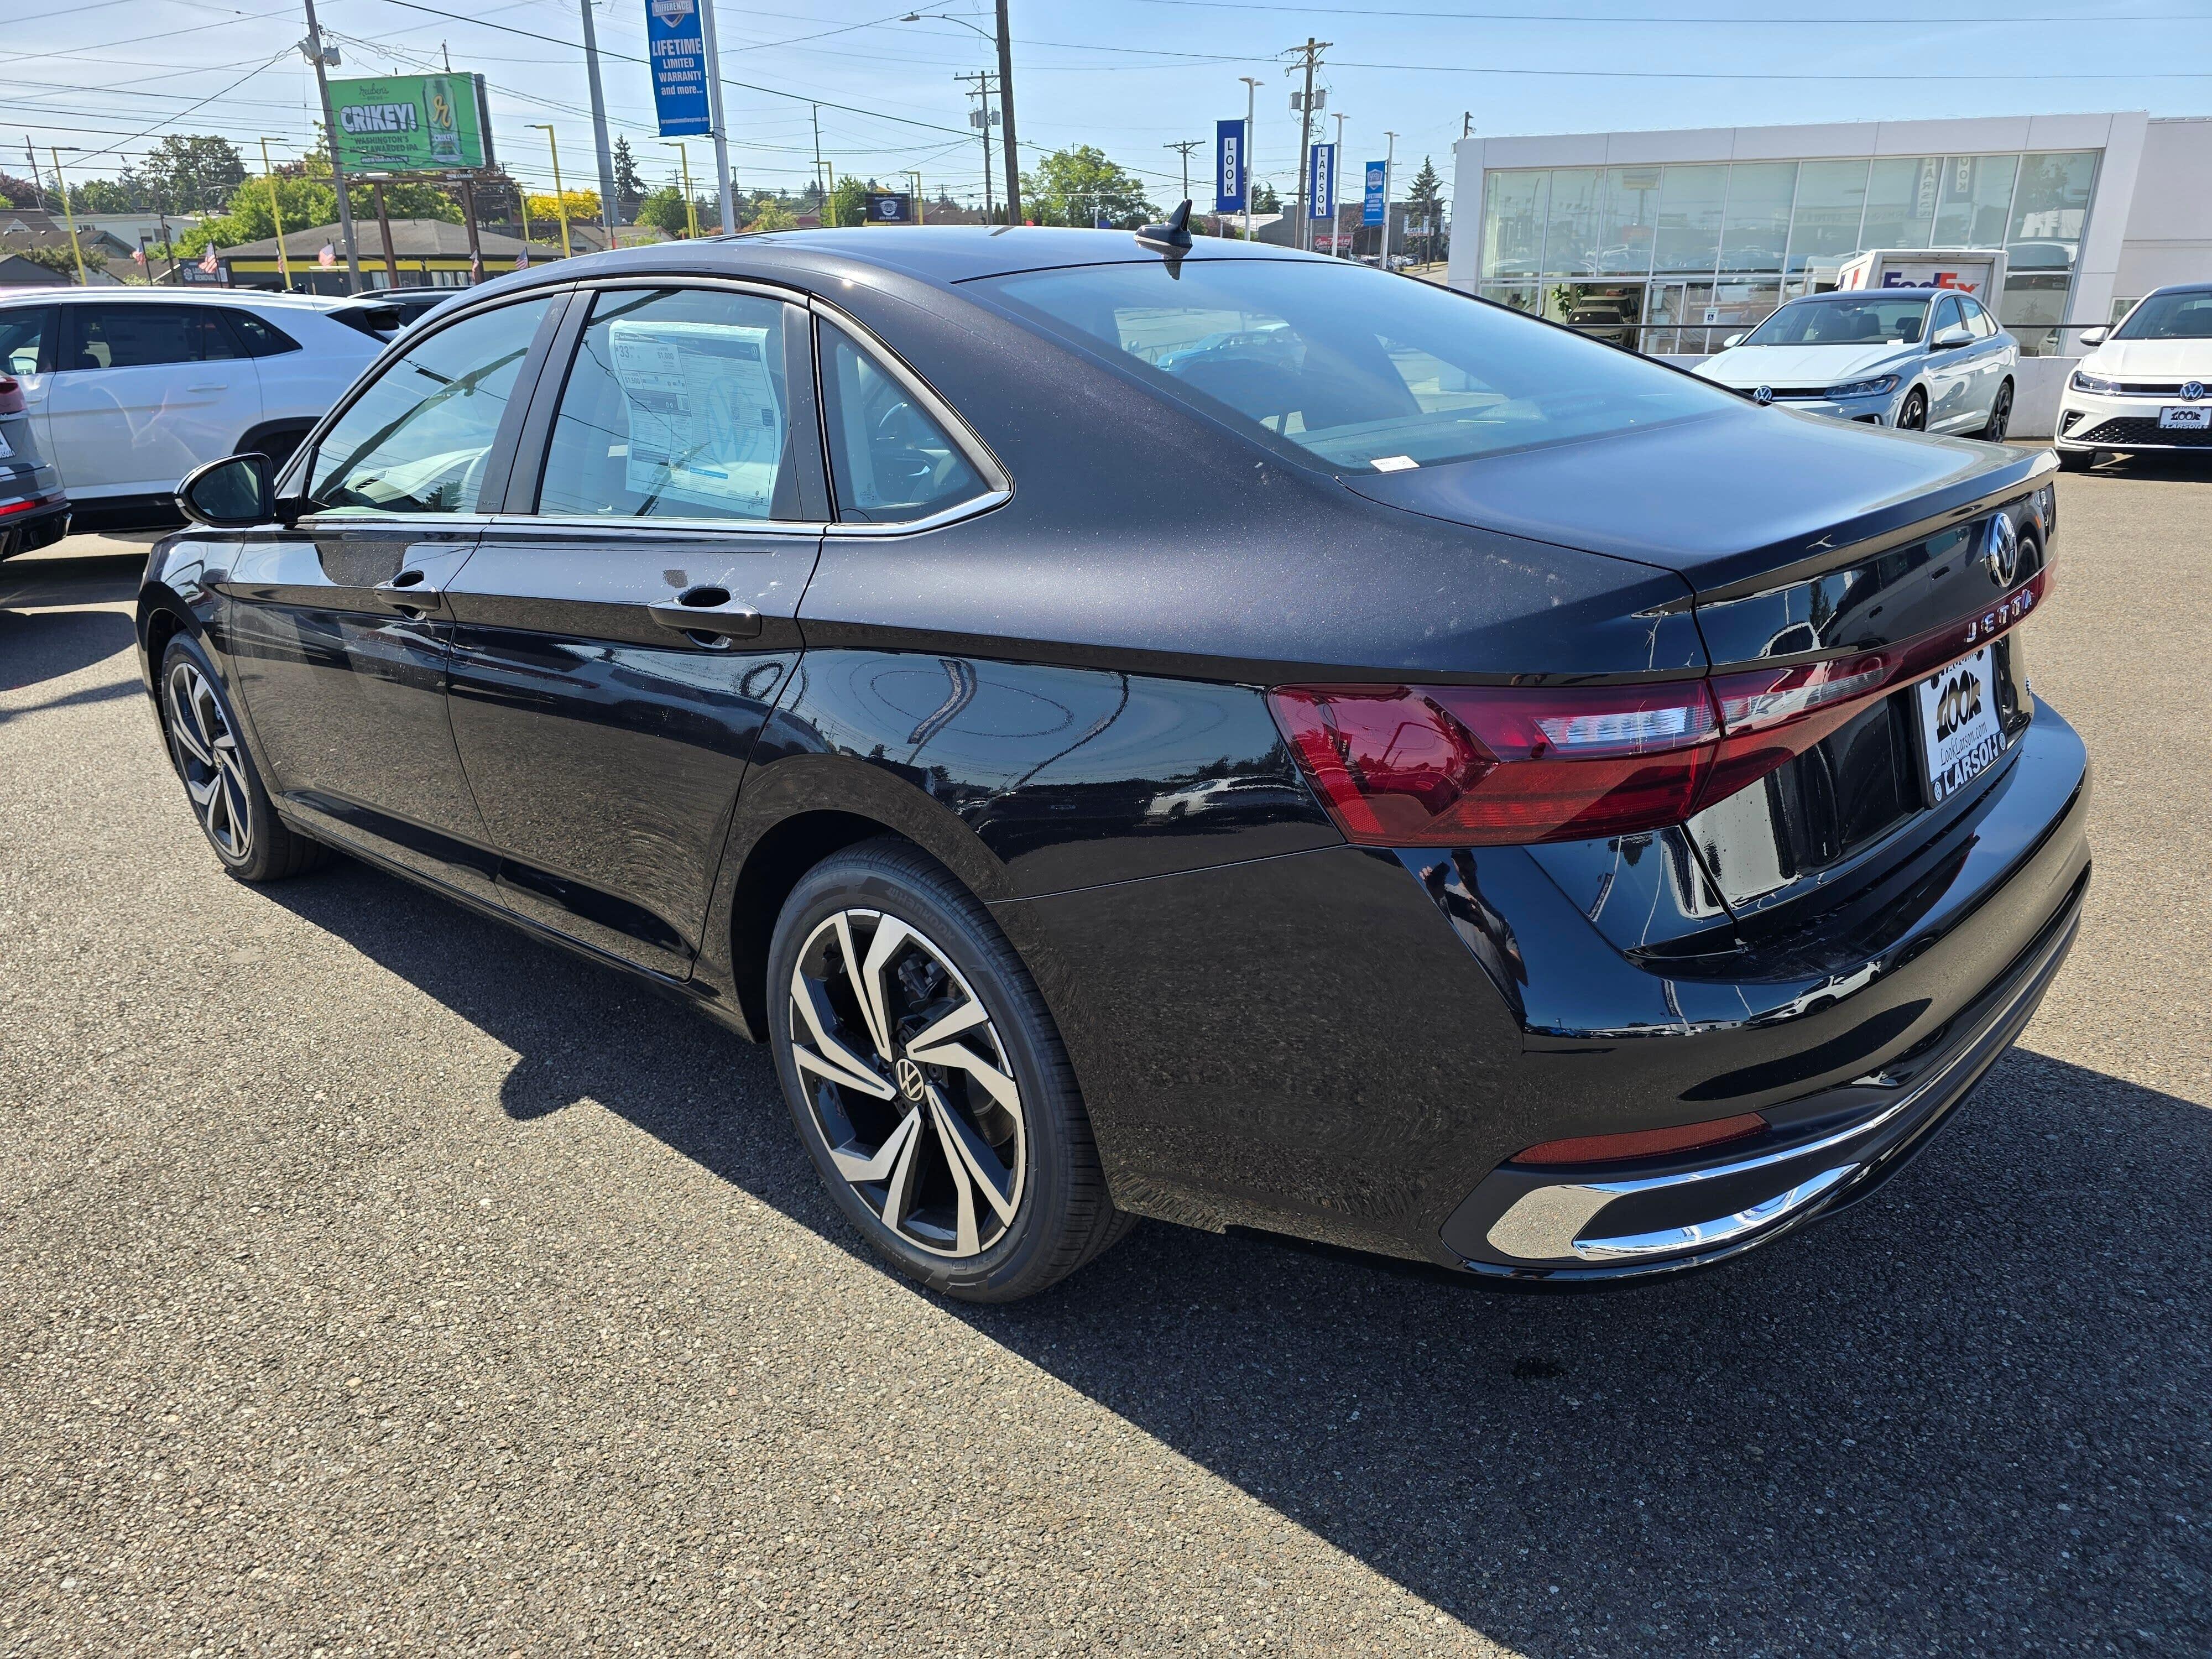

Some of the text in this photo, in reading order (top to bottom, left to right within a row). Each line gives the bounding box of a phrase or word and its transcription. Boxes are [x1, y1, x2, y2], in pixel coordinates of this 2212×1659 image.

[655, 1, 690, 12] DIFFERENCE
[652, 38, 702, 56] LIFETIME
[662, 58, 695, 69] LIMITED
[658, 70, 702, 82] WARRANTY
[661, 85, 703, 96] and more...
[340, 102, 418, 134] CRIKEY!
[354, 136, 409, 144] WASHINGTON'S
[1225, 140, 1234, 194] LOOK
[1964, 588, 2034, 643] JETTA
[1940, 721, 1987, 766] LookLarson.com
[1943, 734, 1999, 796] LARSON
